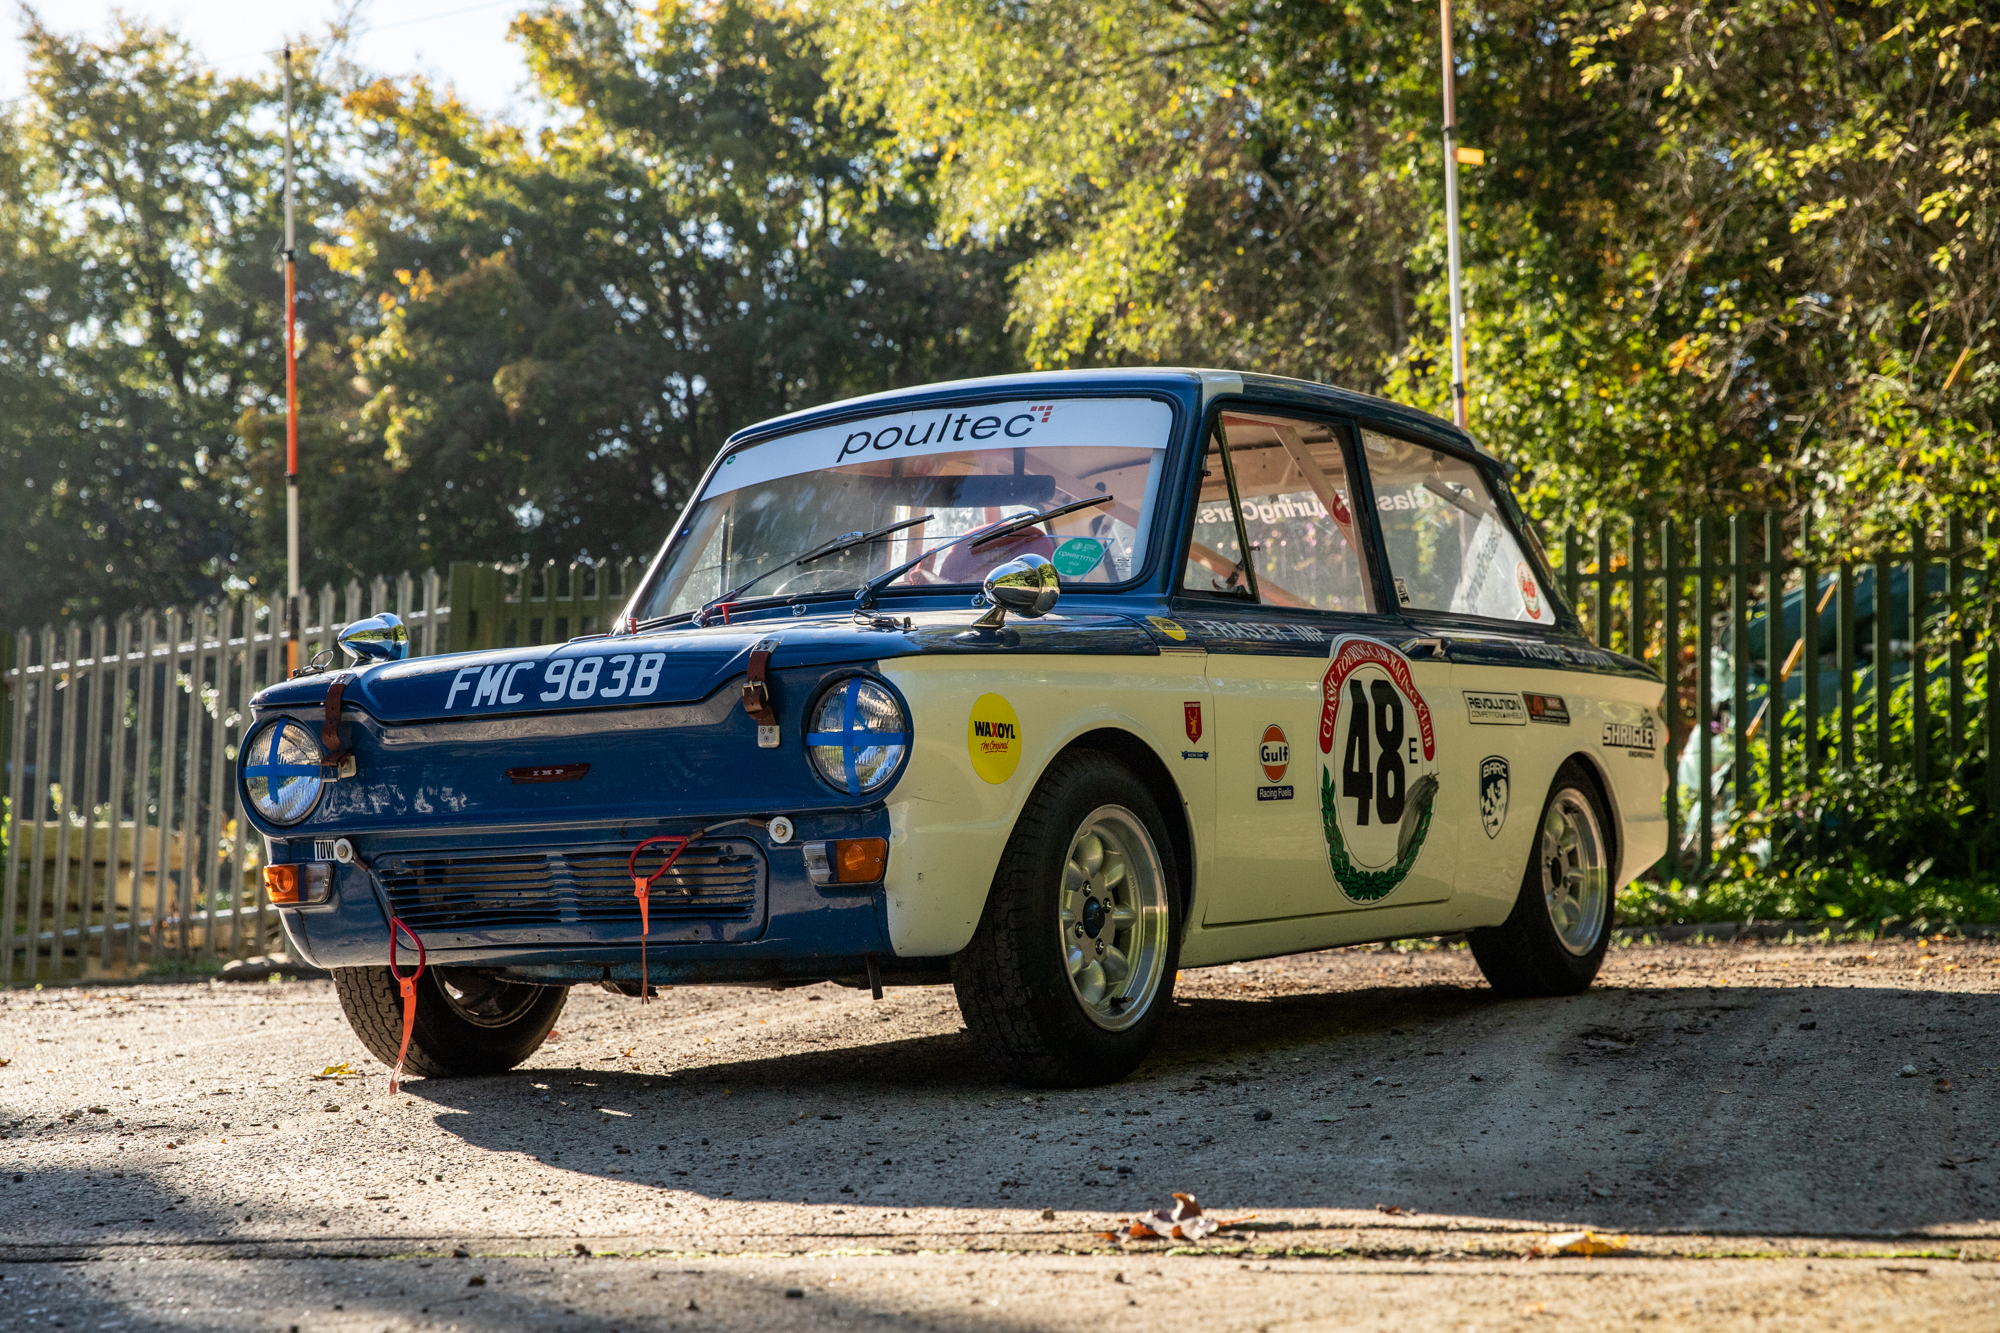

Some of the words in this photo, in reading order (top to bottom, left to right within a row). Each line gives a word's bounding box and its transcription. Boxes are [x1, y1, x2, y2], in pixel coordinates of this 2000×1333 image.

[836, 413, 1035, 463] poultec
[1523, 579, 1535, 598] 40
[1197, 620, 1290, 641] FRASER
[1511, 640, 1573, 662] FREDDIE
[445, 661, 535, 710] FMC
[540, 652, 666, 702] 983B
[1322, 672, 1339, 738] CLASSIC
[1336, 644, 1370, 677] TOURING
[1367, 645, 1390, 664] CAR
[1389, 654, 1417, 703] RACING
[1418, 703, 1432, 748] CLUB
[1467, 697, 1521, 710] REVOLUTION
[1471, 710, 1502, 718] COMPETITION
[974, 721, 1016, 739] WAXOYL
[1602, 723, 1656, 750] SHRIGLEY
[980, 740, 989, 751] The
[989, 739, 1009, 752] Original
[1261, 745, 1288, 762] Gulf
[1343, 678, 1405, 826] 48
[1408, 737, 1418, 764] E
[1483, 762, 1507, 778] BARC
[1260, 788, 1277, 799] Racing
[1278, 787, 1292, 797] Fuels
[316, 842, 334, 859] TOW
